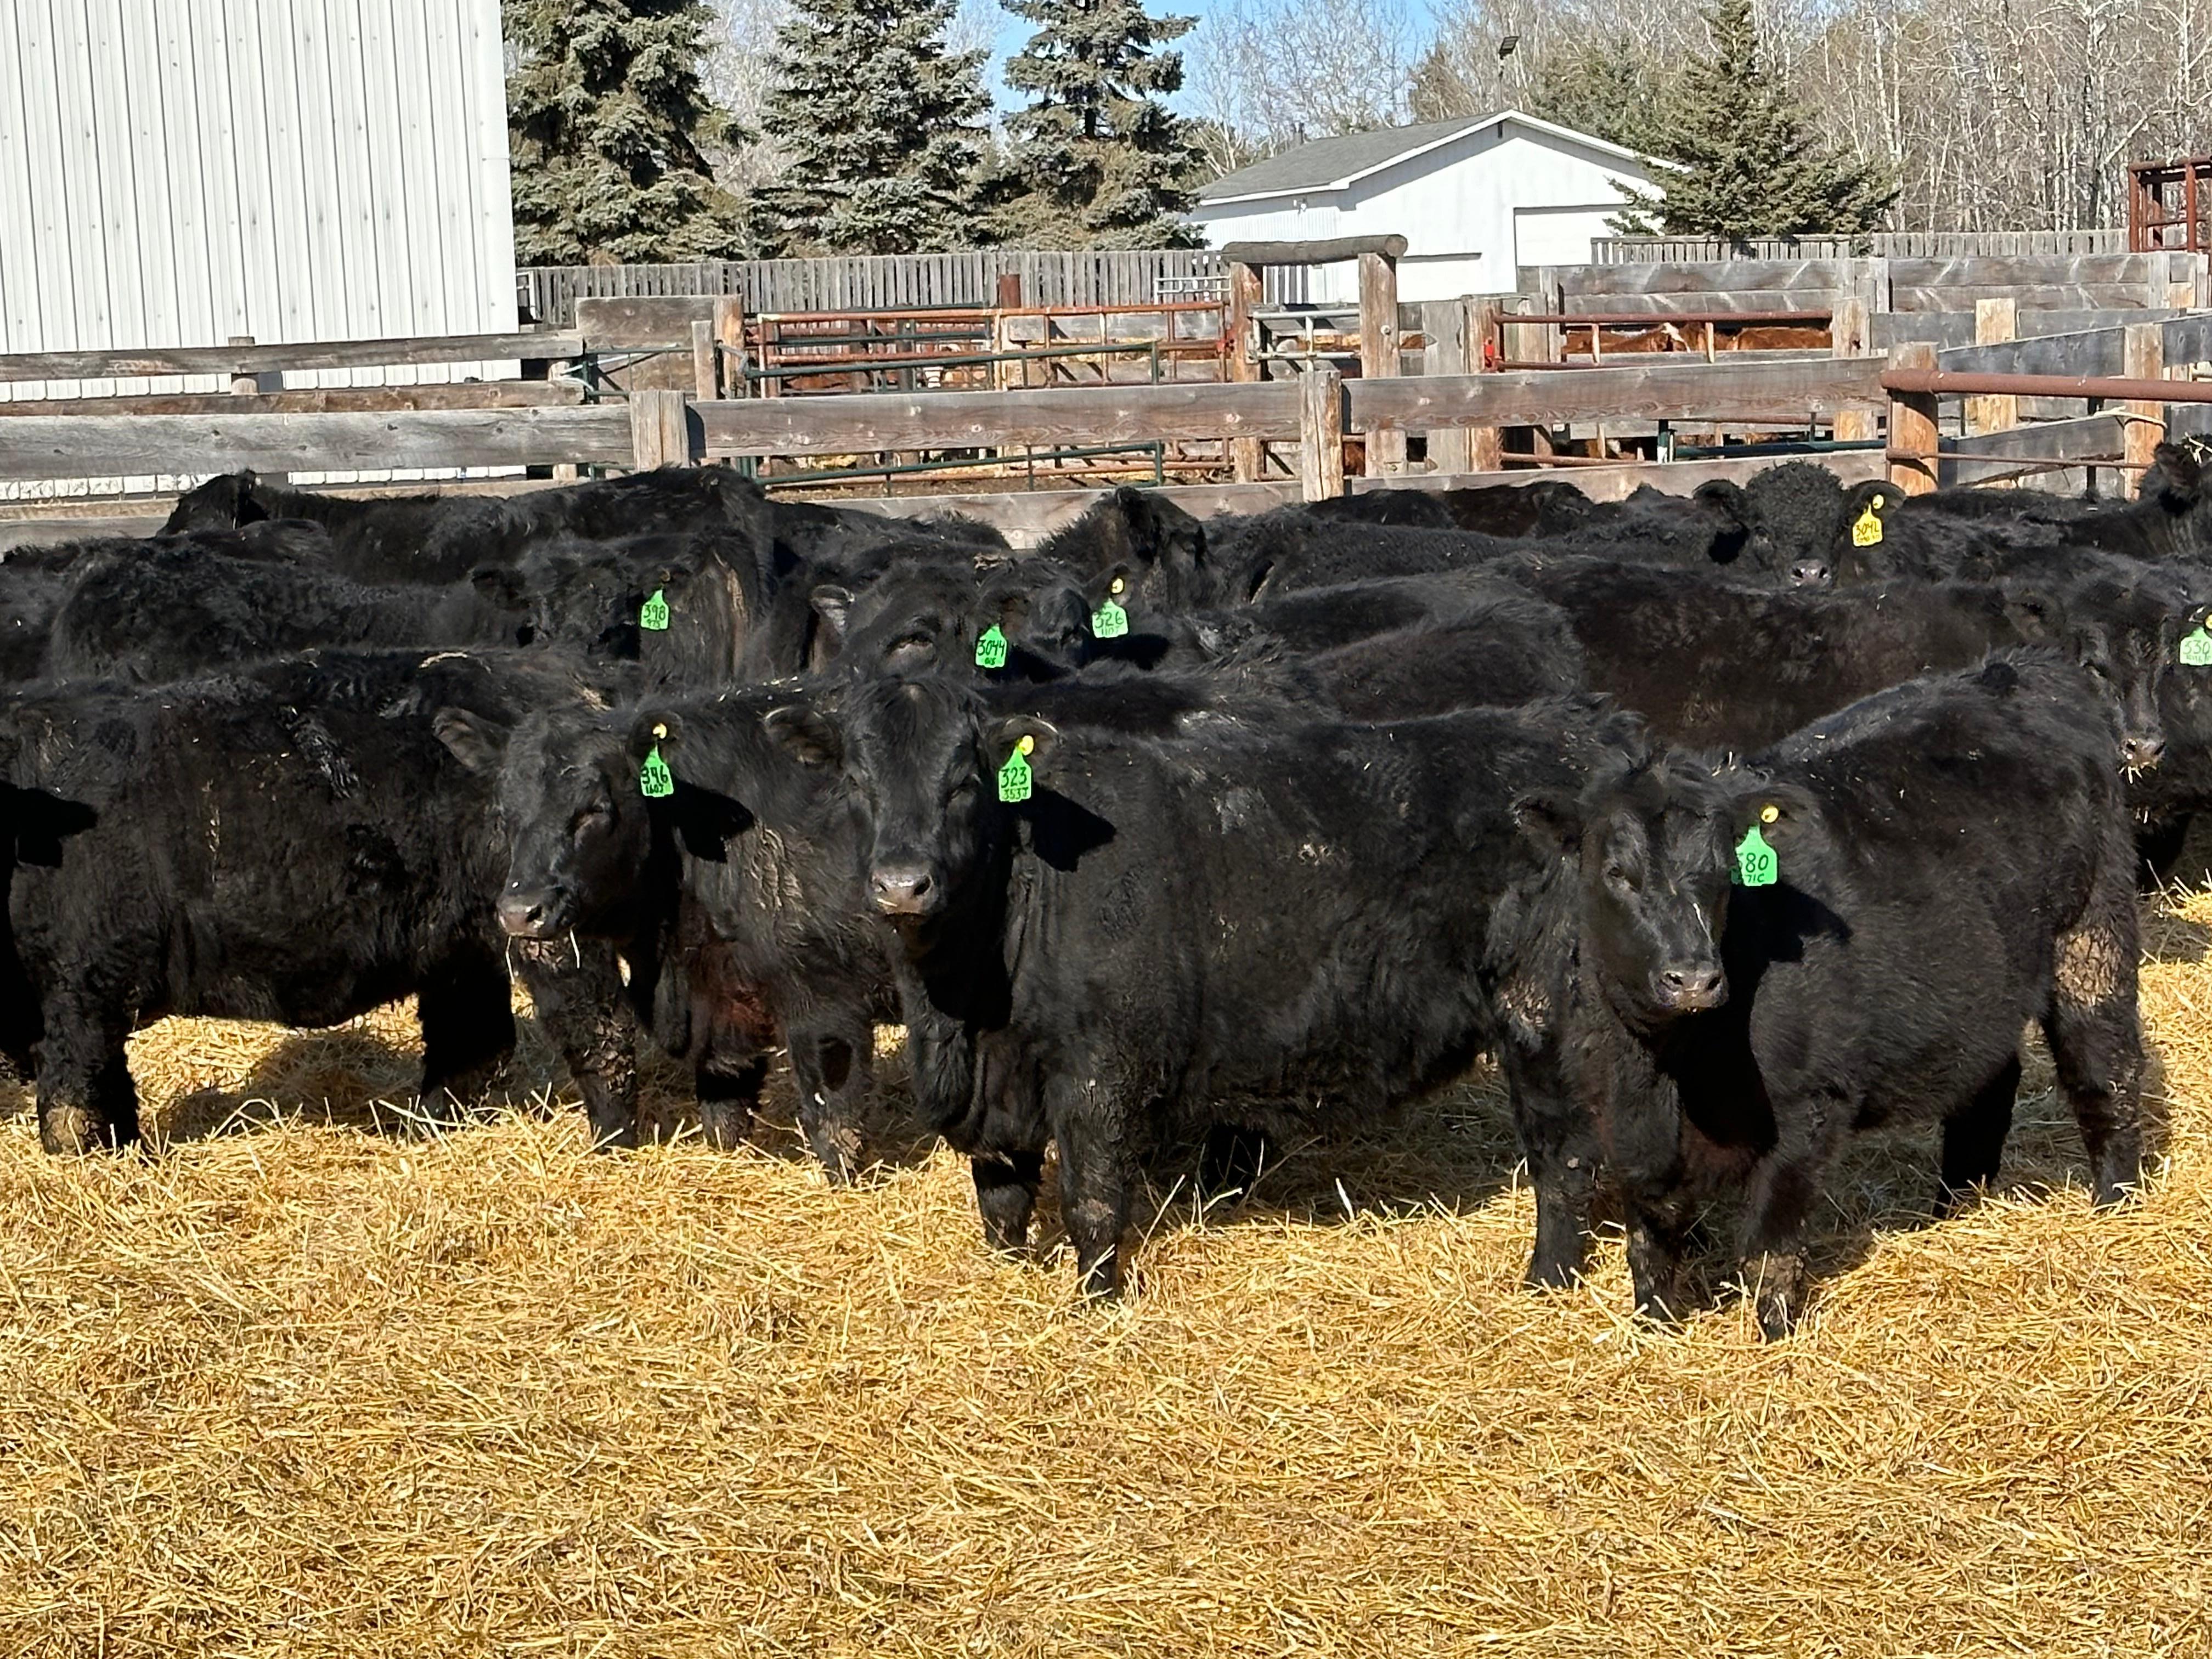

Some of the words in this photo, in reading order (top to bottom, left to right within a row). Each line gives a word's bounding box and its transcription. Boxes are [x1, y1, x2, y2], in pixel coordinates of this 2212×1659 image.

[644, 605, 665, 620] 398
[1094, 611, 1124, 629] 326
[978, 640, 1005, 658] 3044
[640, 765, 668, 784] 396
[1001, 766, 1027, 788] 323
